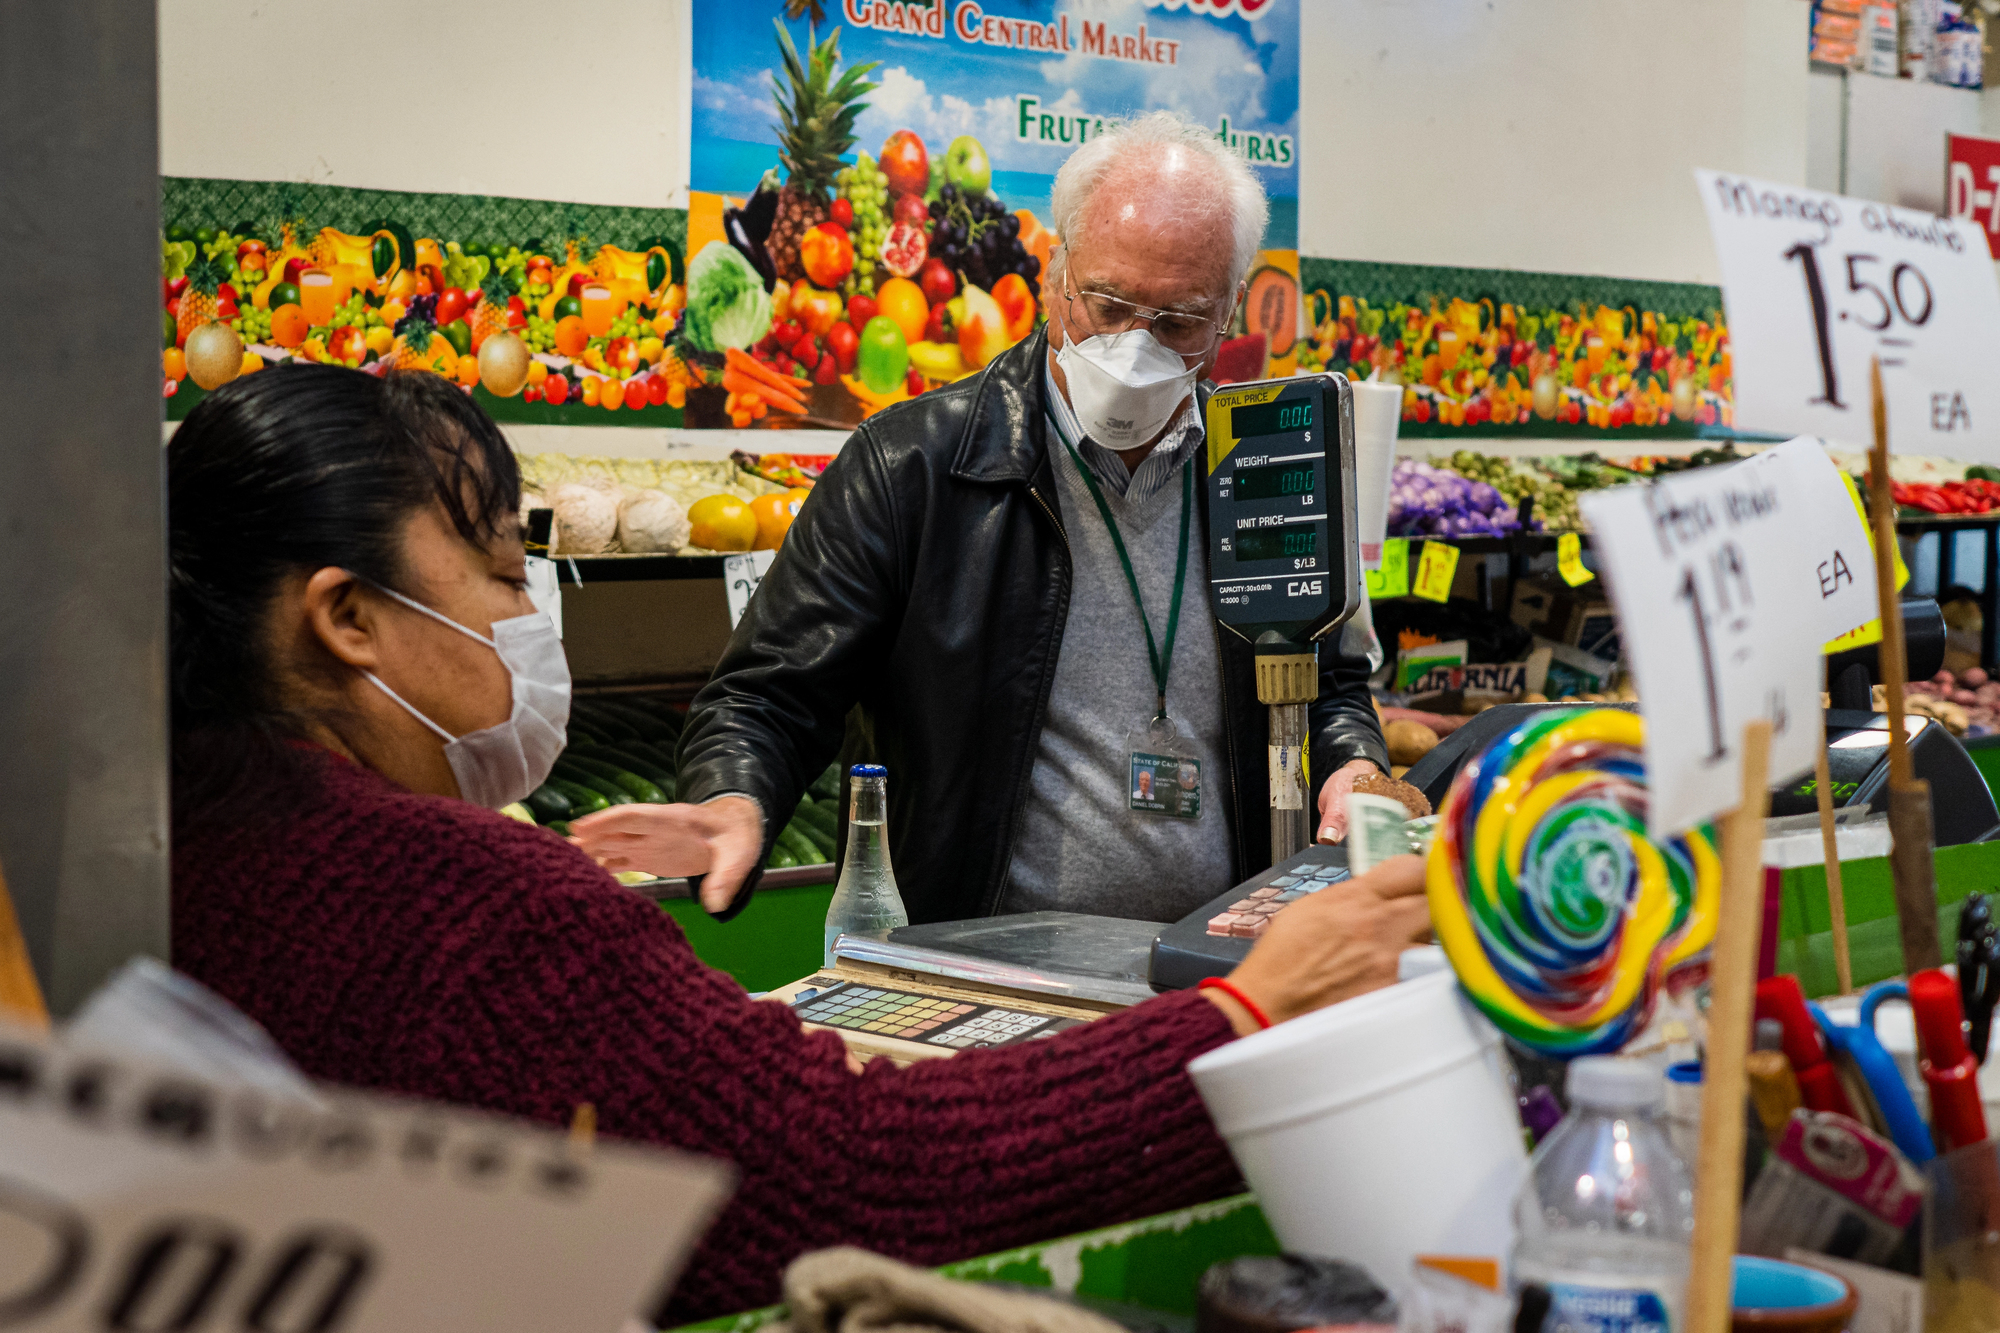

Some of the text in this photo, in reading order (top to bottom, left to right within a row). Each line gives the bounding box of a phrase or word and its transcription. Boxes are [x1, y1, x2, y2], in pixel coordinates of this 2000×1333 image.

[1215, 392, 1269, 408] TOTAL PRICE
[1931, 392, 1970, 431] EA
[1106, 417, 1135, 430] 3M
[1304, 431, 1312, 443] $
[1235, 455, 1269, 468] WEIGHT
[1219, 477, 1233, 486] ZERO
[1219, 489, 1230, 498] NET
[1302, 495, 1314, 506] LB
[1237, 514, 1284, 529] UNIT PRICE
[1294, 557, 1317, 570] $/LB
[1816, 549, 1854, 600] EA
[1287, 580, 1323, 597] CAS
